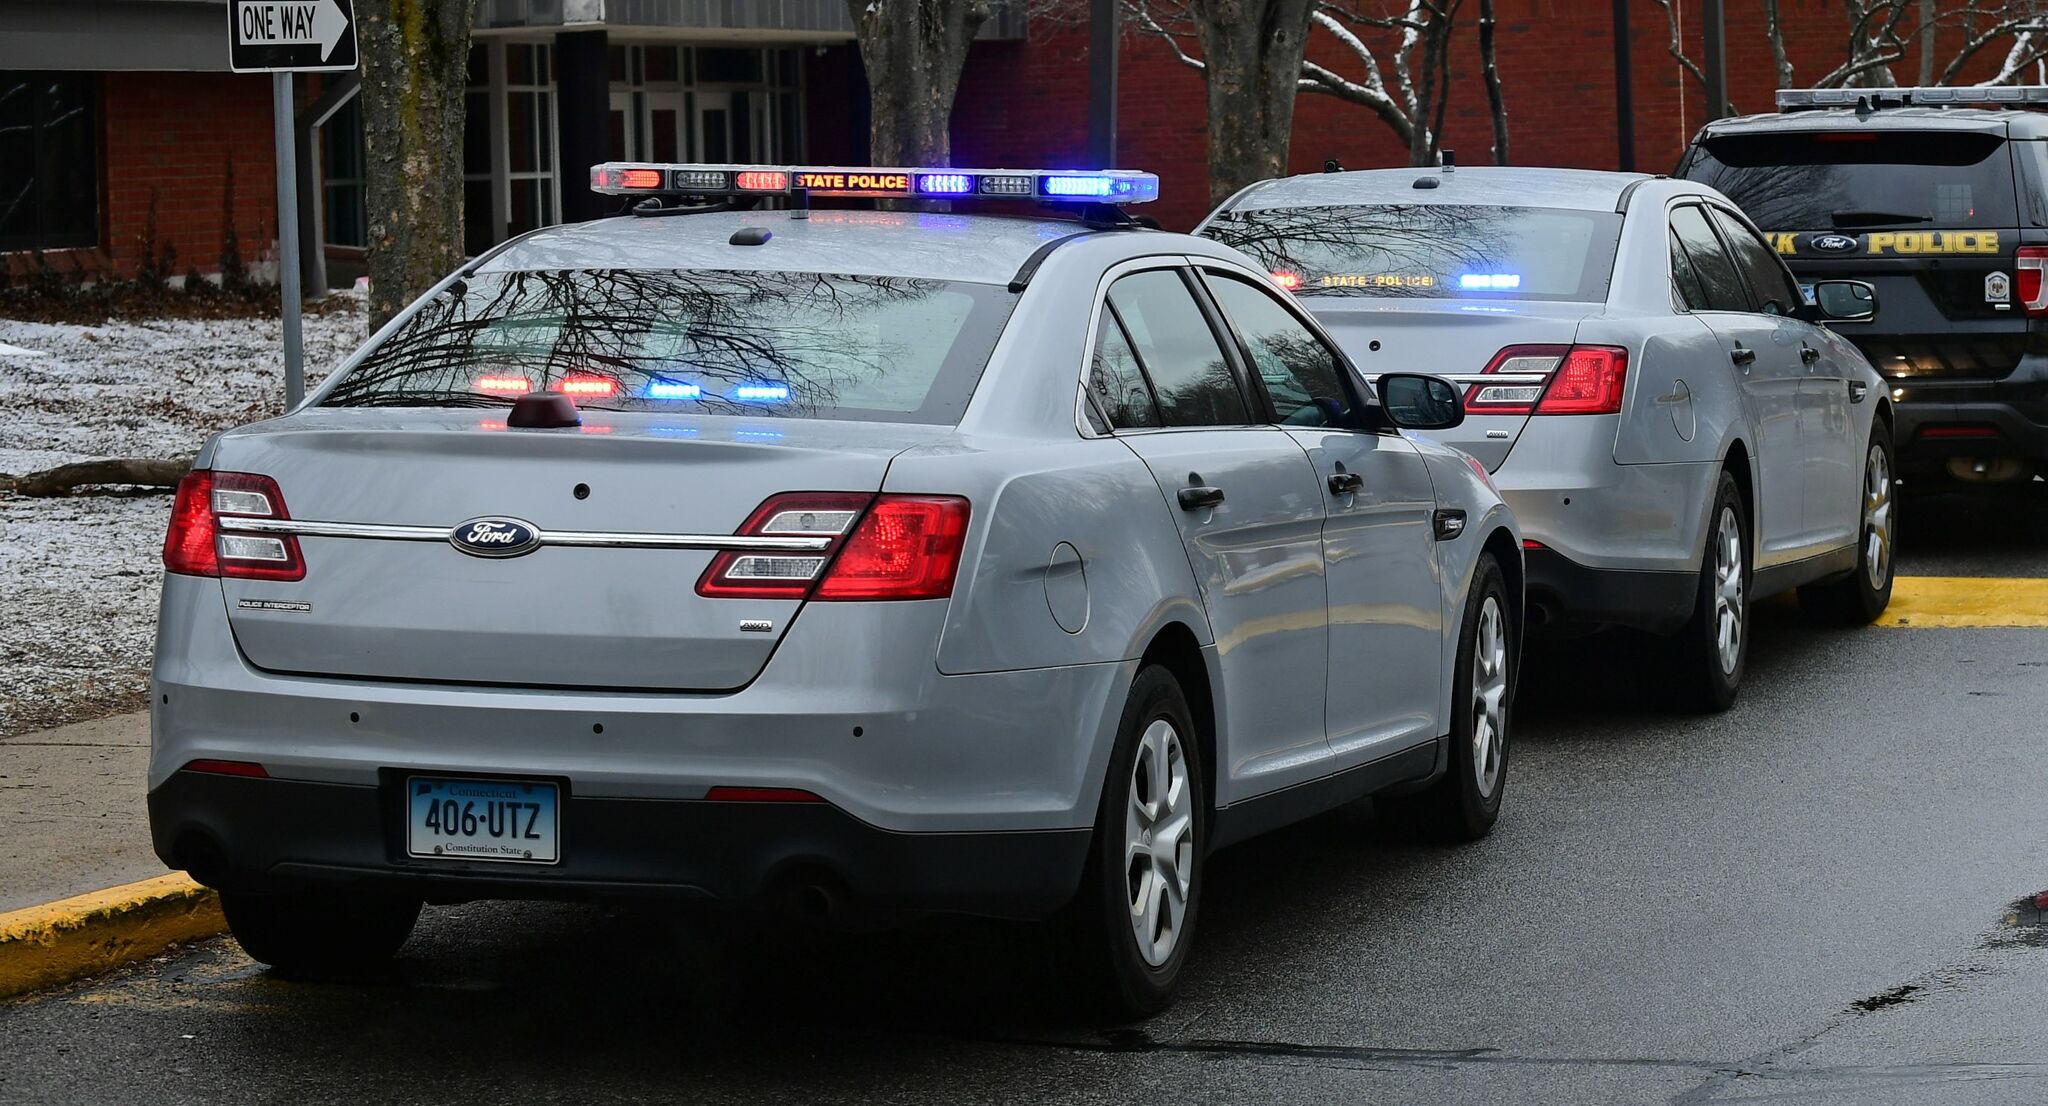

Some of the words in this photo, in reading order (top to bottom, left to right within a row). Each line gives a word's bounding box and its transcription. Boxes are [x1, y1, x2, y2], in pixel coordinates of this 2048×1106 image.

[243, 5, 276, 40] ONE
[280, 5, 316, 39] WAY
[796, 174, 844, 188] STATE
[848, 175, 907, 188] POLICE
[1866, 232, 1999, 254] POLICE
[1321, 276, 1366, 286] STATE
[1376, 276, 1433, 286] POLICE
[467, 522, 517, 543] Ford
[263, 602, 310, 610] INTERCEPTOR
[741, 621, 771, 630] AWD
[450, 786, 517, 799] Connecticut
[445, 842, 498, 853] Constitution
[500, 845, 522, 855] State
